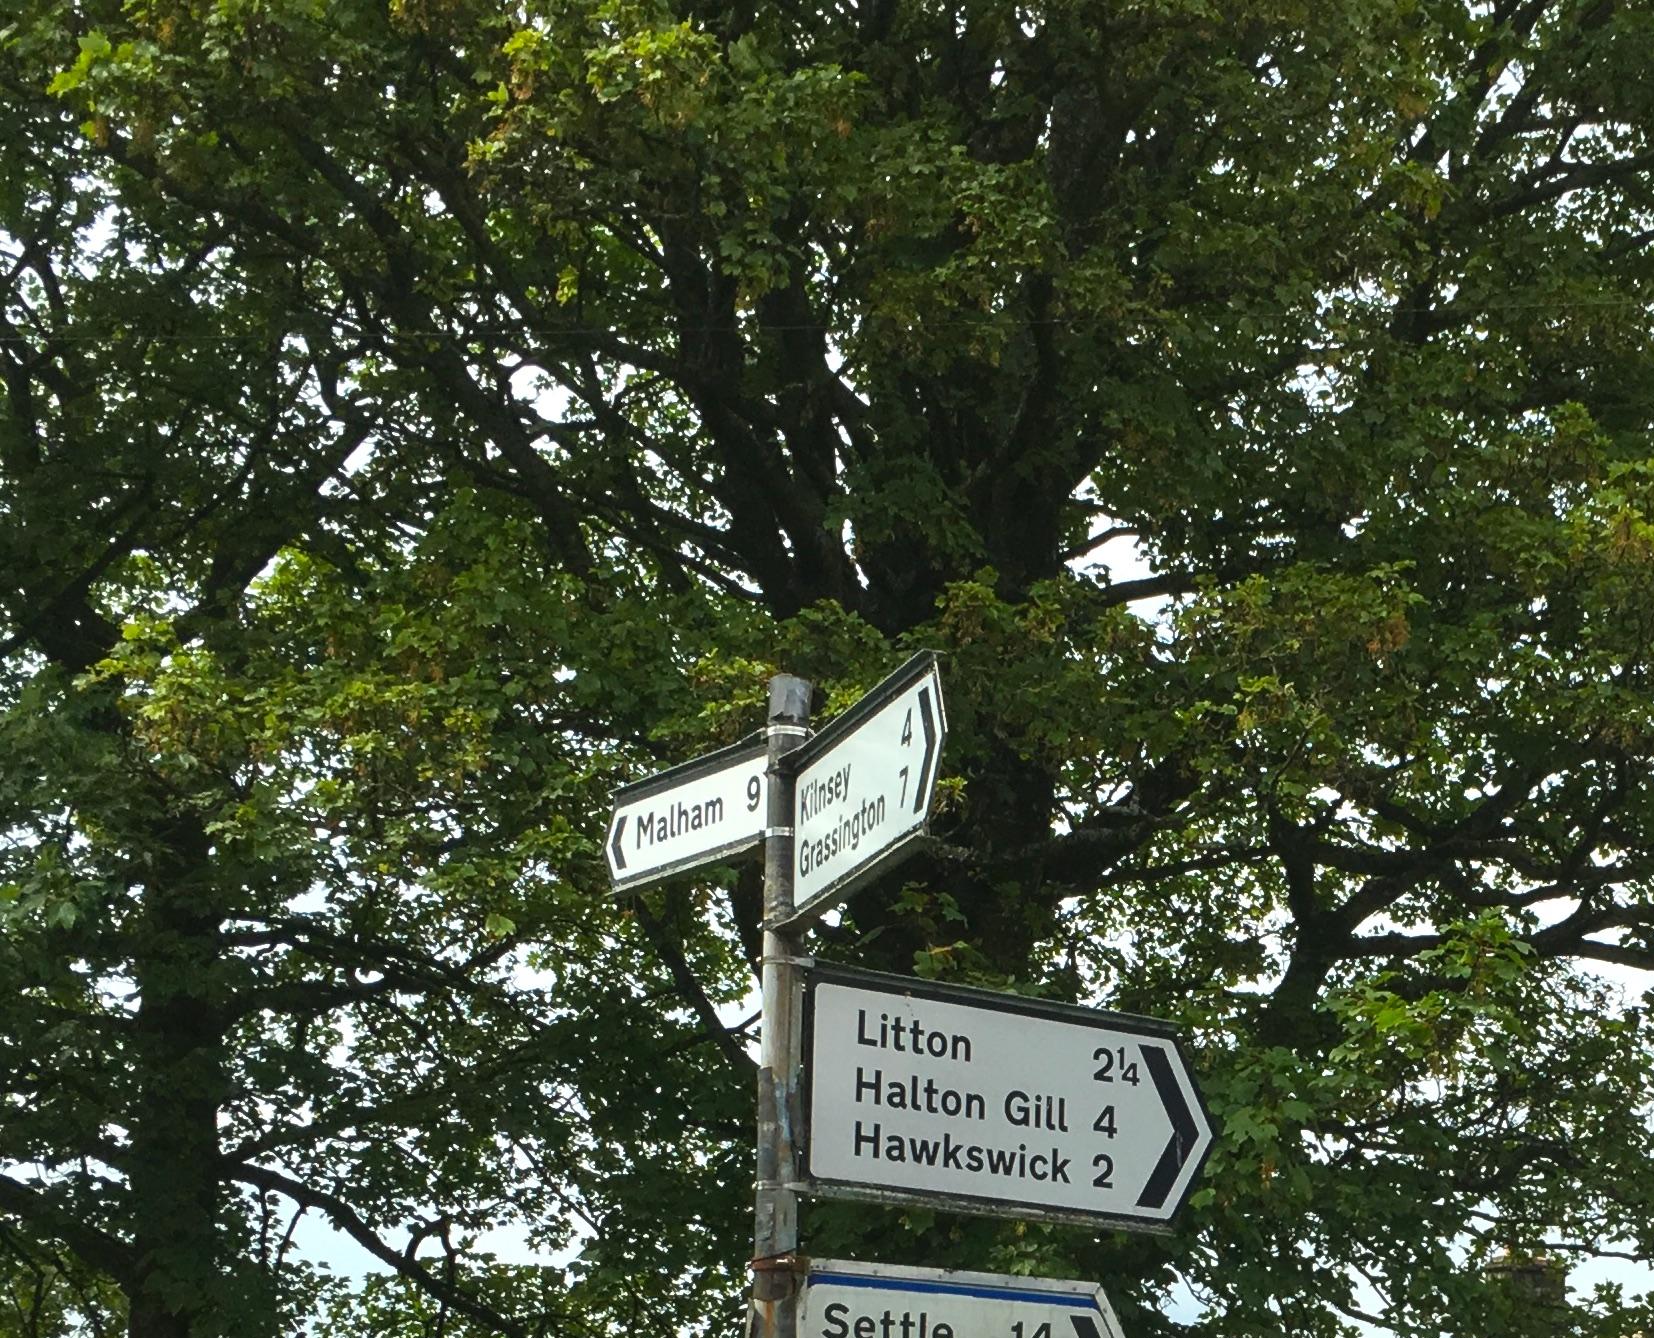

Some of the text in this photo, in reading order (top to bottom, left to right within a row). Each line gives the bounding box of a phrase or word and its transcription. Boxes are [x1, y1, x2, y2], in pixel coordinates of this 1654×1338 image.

[800, 708, 913, 826] Kilnsey 4
[636, 776, 761, 849] Malham 9
[799, 766, 909, 877] Grassington 7
[857, 1009, 972, 1063] Litton
[855, 1067, 1118, 1139] Halton Gill 4
[854, 1121, 1114, 1189] Hawkswick 2
